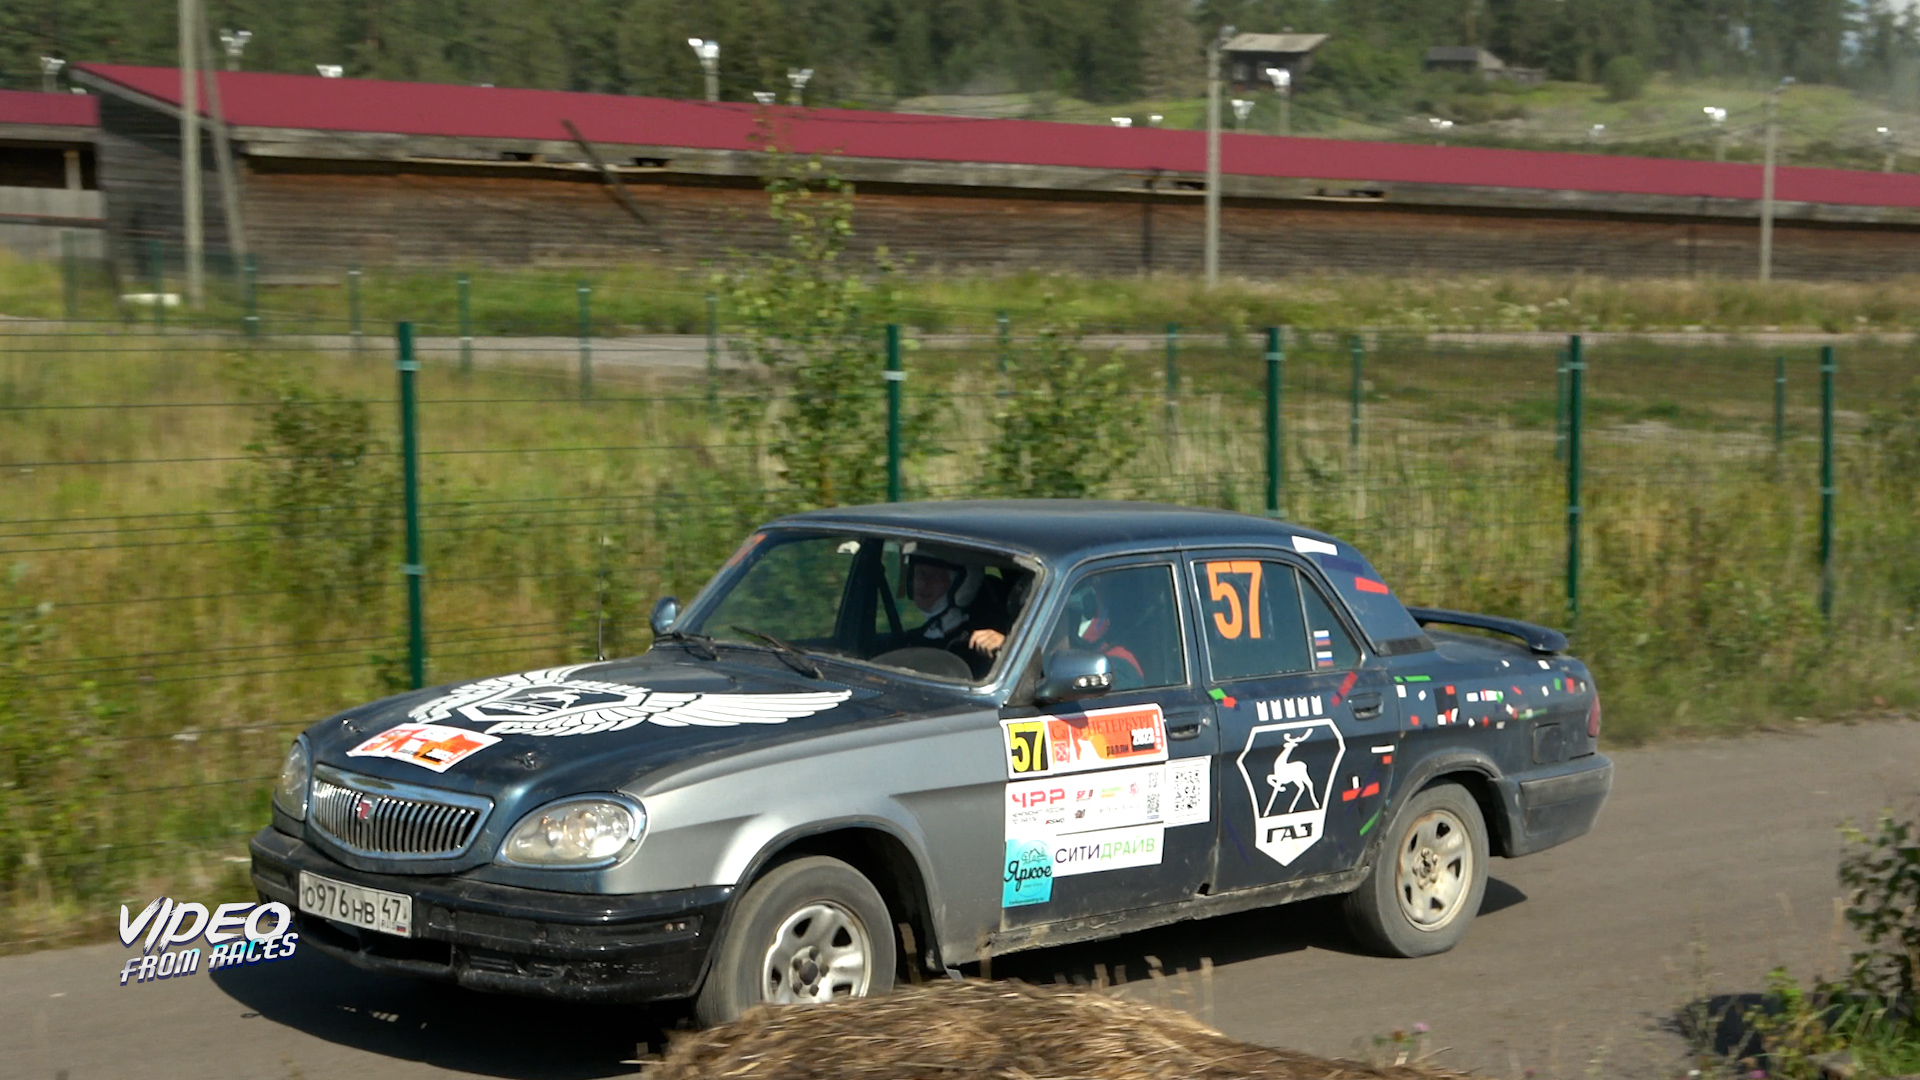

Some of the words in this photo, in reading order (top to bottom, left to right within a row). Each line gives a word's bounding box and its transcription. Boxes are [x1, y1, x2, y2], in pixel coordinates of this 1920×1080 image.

[1206, 561, 1262, 640] 57
[1007, 721, 1045, 773] 57
[1266, 822, 1313, 843] ГАЗ
[1055, 836, 1155, 864] СИТИДРАЙВ
[1003, 860, 1053, 892] Яркое
[382, 898, 401, 921] 47
